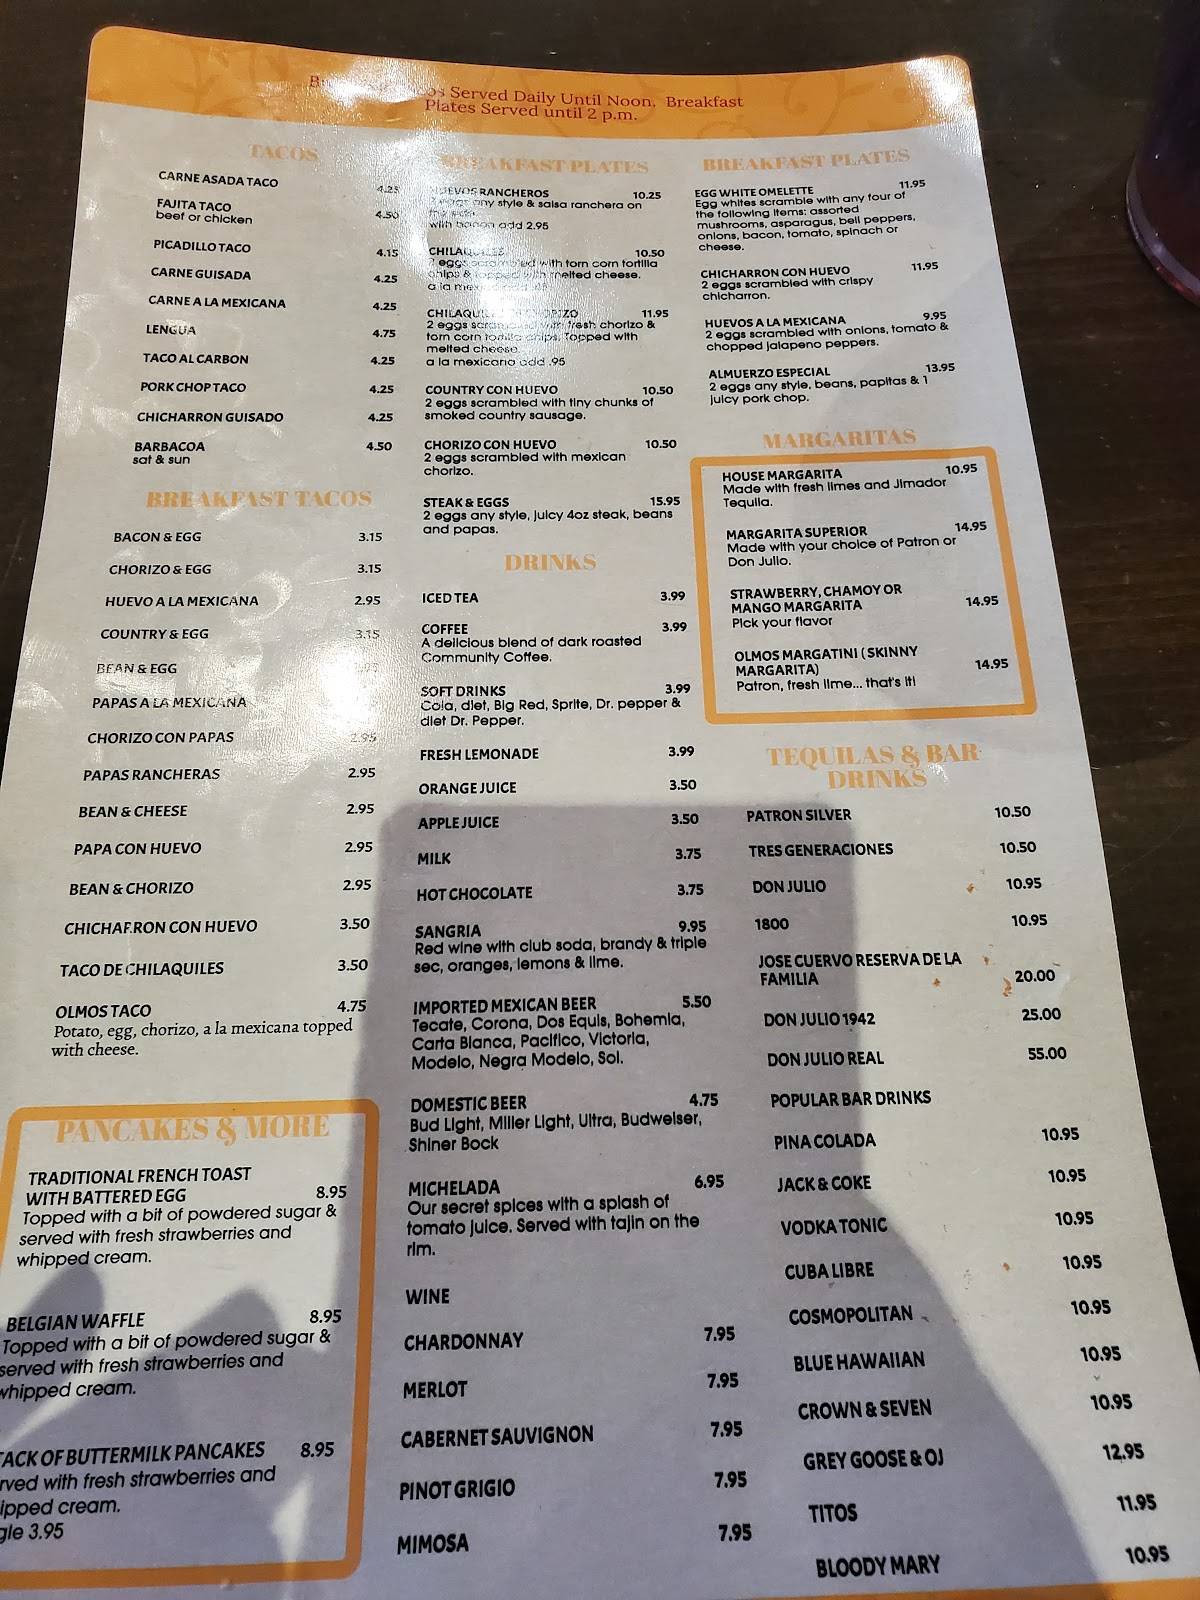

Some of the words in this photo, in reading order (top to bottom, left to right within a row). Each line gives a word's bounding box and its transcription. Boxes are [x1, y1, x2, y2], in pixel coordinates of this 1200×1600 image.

[450, 86, 508, 101] Served
[514, 90, 556, 106] Daily
[561, 93, 601, 106] Until
[666, 95, 744, 108] Breakfast
[425, 99, 476, 114] Plates
[481, 102, 538, 118] Served
[545, 106, 583, 119] until
[587, 108, 597, 120] 2
[602, 109, 638, 123] p.m.
[249, 144, 320, 162] TACOS
[703, 154, 826, 172] BREAKFAST
[831, 149, 911, 167] PLATES
[899, 180, 925, 189] 11.95
[719, 189, 756, 197] WHITE
[759, 187, 814, 196] OMELETTE
[157, 199, 196, 210] FAJITA
[199, 202, 231, 212] TACO
[156, 211, 184, 222] beef
[204, 213, 253, 224] chicken
[718, 209, 770, 218] following
[154, 240, 216, 251] PICADILLO
[218, 243, 251, 253] TACO
[151, 267, 193, 278] CARNE
[195, 270, 251, 280] GUISADA
[702, 291, 771, 301] chicharron.
[923, 312, 946, 320] 9.95
[372, 329, 396, 337] 4.75
[709, 369, 773, 379] ALMUERZO
[776, 367, 830, 377] ESPECIAL
[426, 386, 484, 394] COUNTRY
[487, 386, 512, 394] CON
[516, 386, 558, 394] HUEVO
[643, 386, 673, 395] 10.50
[137, 412, 222, 422] CHICHARRON
[226, 413, 283, 422] GUISADO
[425, 411, 475, 420] smoked
[479, 411, 526, 421] country
[530, 412, 585, 422] sausage.
[763, 428, 918, 449] MARGARITAS
[135, 442, 205, 452] BARBACOA
[366, 442, 392, 451] 4.50
[435, 455, 467, 464] eggs
[471, 452, 538, 462] scrambled
[542, 452, 567, 461] with
[571, 452, 626, 461] mexican
[722, 471, 765, 482] HOUSE
[767, 469, 842, 481] MARGARITA
[946, 464, 977, 474] 10.95
[723, 484, 761, 494] Made
[764, 483, 789, 492] with
[794, 482, 823, 492] fresh
[827, 482, 860, 491] limes
[864, 480, 890, 489] and
[894, 478, 946, 488] Jimador
[146, 491, 289, 509] BREAKFAST
[294, 490, 373, 507] TACOS
[650, 497, 680, 506] 15.95
[723, 497, 772, 509] Tequila.
[114, 532, 160, 542] BACON
[163, 533, 172, 542] &
[176, 532, 201, 542] EGG
[359, 533, 382, 541] 3.15
[504, 554, 597, 572] DRINKS
[730, 587, 821, 599] STRAWBERRY,
[824, 585, 881, 597] CHAMOY
[884, 584, 902, 594] OR
[966, 596, 998, 606] 14.95
[422, 624, 468, 634] COFFEE
[662, 622, 687, 632] 3.99
[733, 618, 758, 628] Pick
[762, 619, 791, 629] your
[795, 616, 832, 626] flavor
[435, 638, 494, 648] delicious
[499, 637, 536, 647] blend
[541, 637, 554, 647] of
[558, 637, 587, 647] dark
[592, 636, 641, 646] roasted
[766, 745, 894, 770] TEQUILAS
[901, 745, 920, 769] &
[927, 743, 979, 763] BAR
[84, 770, 129, 781] PAPAS
[132, 769, 220, 780] RANCHERAS
[348, 768, 375, 778] 2.95
[827, 769, 928, 791] DRINKS
[747, 810, 802, 822] PATRON
[806, 809, 851, 821] SILVER
[995, 806, 1031, 818] 10.50
[676, 848, 701, 859] 3.75
[749, 845, 782, 857] TRES
[785, 843, 893, 856] GENERACIONES
[418, 852, 451, 865] MILK
[417, 888, 447, 900] HOT
[449, 886, 532, 900] CHOCOLATE
[755, 918, 789, 930] 1800
[415, 924, 482, 939] SANGRIA
[338, 959, 368, 971] 3.50
[1015, 969, 1055, 982] 20.00
[414, 1000, 488, 1015] IMPORTED
[491, 997, 557, 1012] MEXICAN
[562, 997, 596, 1011] BEER
[683, 995, 711, 1008] 5.50
[412, 1018, 466, 1032] Tecate,
[472, 1017, 532, 1030] Corona,
[537, 1015, 564, 1028] Dos
[570, 1014, 610, 1030] Equis,
[616, 1011, 684, 1029] Bohemia,
[54, 1026, 103, 1039] Potato,
[108, 1027, 136, 1040] egg,
[142, 1022, 198, 1037] chorizo,
[55, 1118, 209, 1143] PANCAKES
[216, 1117, 236, 1146] &
[241, 1115, 331, 1138] MORE
[774, 1135, 811, 1150] PINA
[813, 1133, 876, 1148] COLADA
[29, 1170, 134, 1185] TRADITIONAL
[138, 1168, 198, 1182] FRENCH
[202, 1167, 252, 1181] TOAST
[316, 1185, 347, 1199] 8.95
[781, 1219, 835, 1236] VODKA
[839, 1217, 888, 1233] TONIC
[19, 1231, 74, 1246] served
[79, 1230, 110, 1244] with
[116, 1229, 153, 1242] fresh
[158, 1227, 254, 1241] strawberries
[259, 1225, 291, 1239] and
[406, 1288, 449, 1304] WINE
[1071, 1300, 1111, 1315] 10.95
[789, 1305, 913, 1325] COSMOPOLITAN
[6, 1315, 78, 1332] BELGIAN
[82, 1313, 145, 1329] WAFFLE
[704, 1326, 735, 1341] 7.95
[404, 1332, 523, 1351] CHARDONNAY
[794, 1355, 834, 1372] BLUE
[837, 1351, 925, 1370] HAWAIIAN
[400, 1429, 488, 1449] CABERNET
[491, 1425, 594, 1446] SAUVIGNON
[66, 1445, 172, 1465] BUTTERMILK
[175, 1441, 265, 1461] PANCAKES
[58, 1500, 120, 1514] cream.
[1117, 1494, 1156, 1511] 11.95
[808, 1503, 857, 1523] TITOS
[397, 1533, 469, 1555] MIMOSA
[816, 1556, 886, 1578] BLOODY
[890, 1554, 940, 1575] MARY
